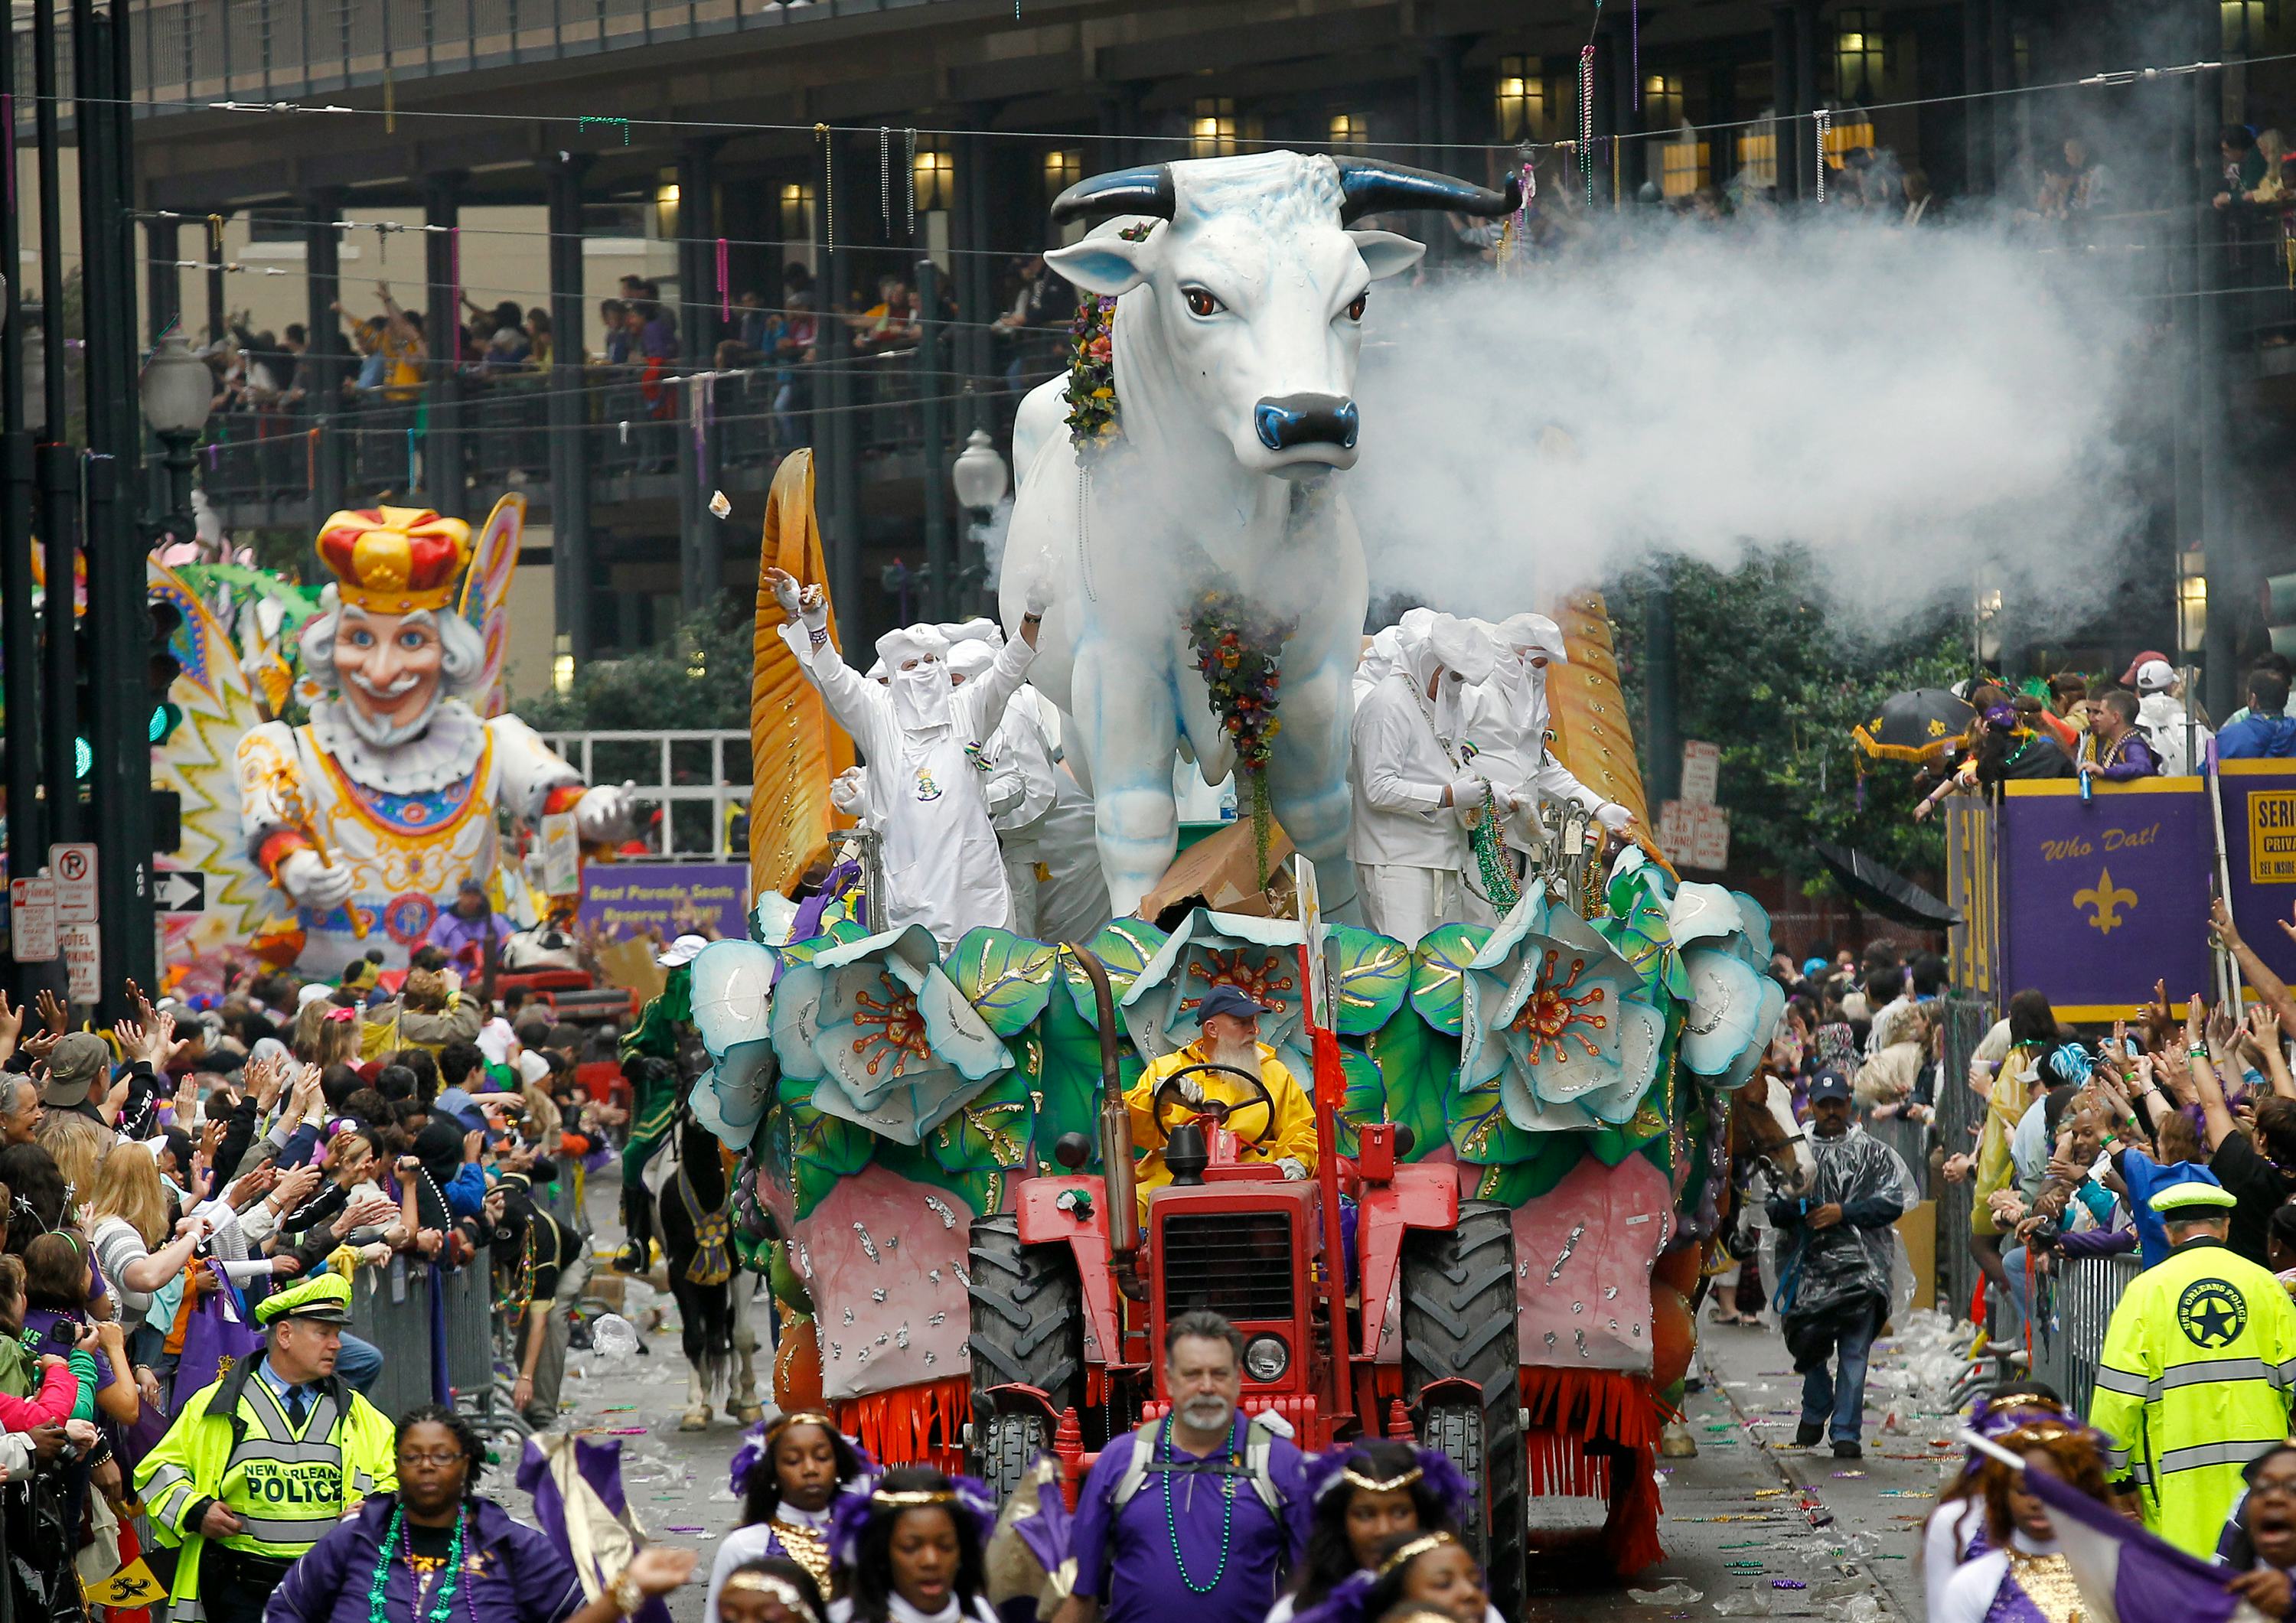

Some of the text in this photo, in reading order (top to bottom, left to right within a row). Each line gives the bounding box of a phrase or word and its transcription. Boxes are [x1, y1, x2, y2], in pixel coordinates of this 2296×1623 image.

[2041, 823, 2161, 862] Who Dat!
[57, 934, 91, 947] HOTEL
[2180, 1283, 2247, 1331] NEW ORLEANS POLICE
[244, 1465, 277, 1476] NEW
[246, 1478, 344, 1503] POLICE
